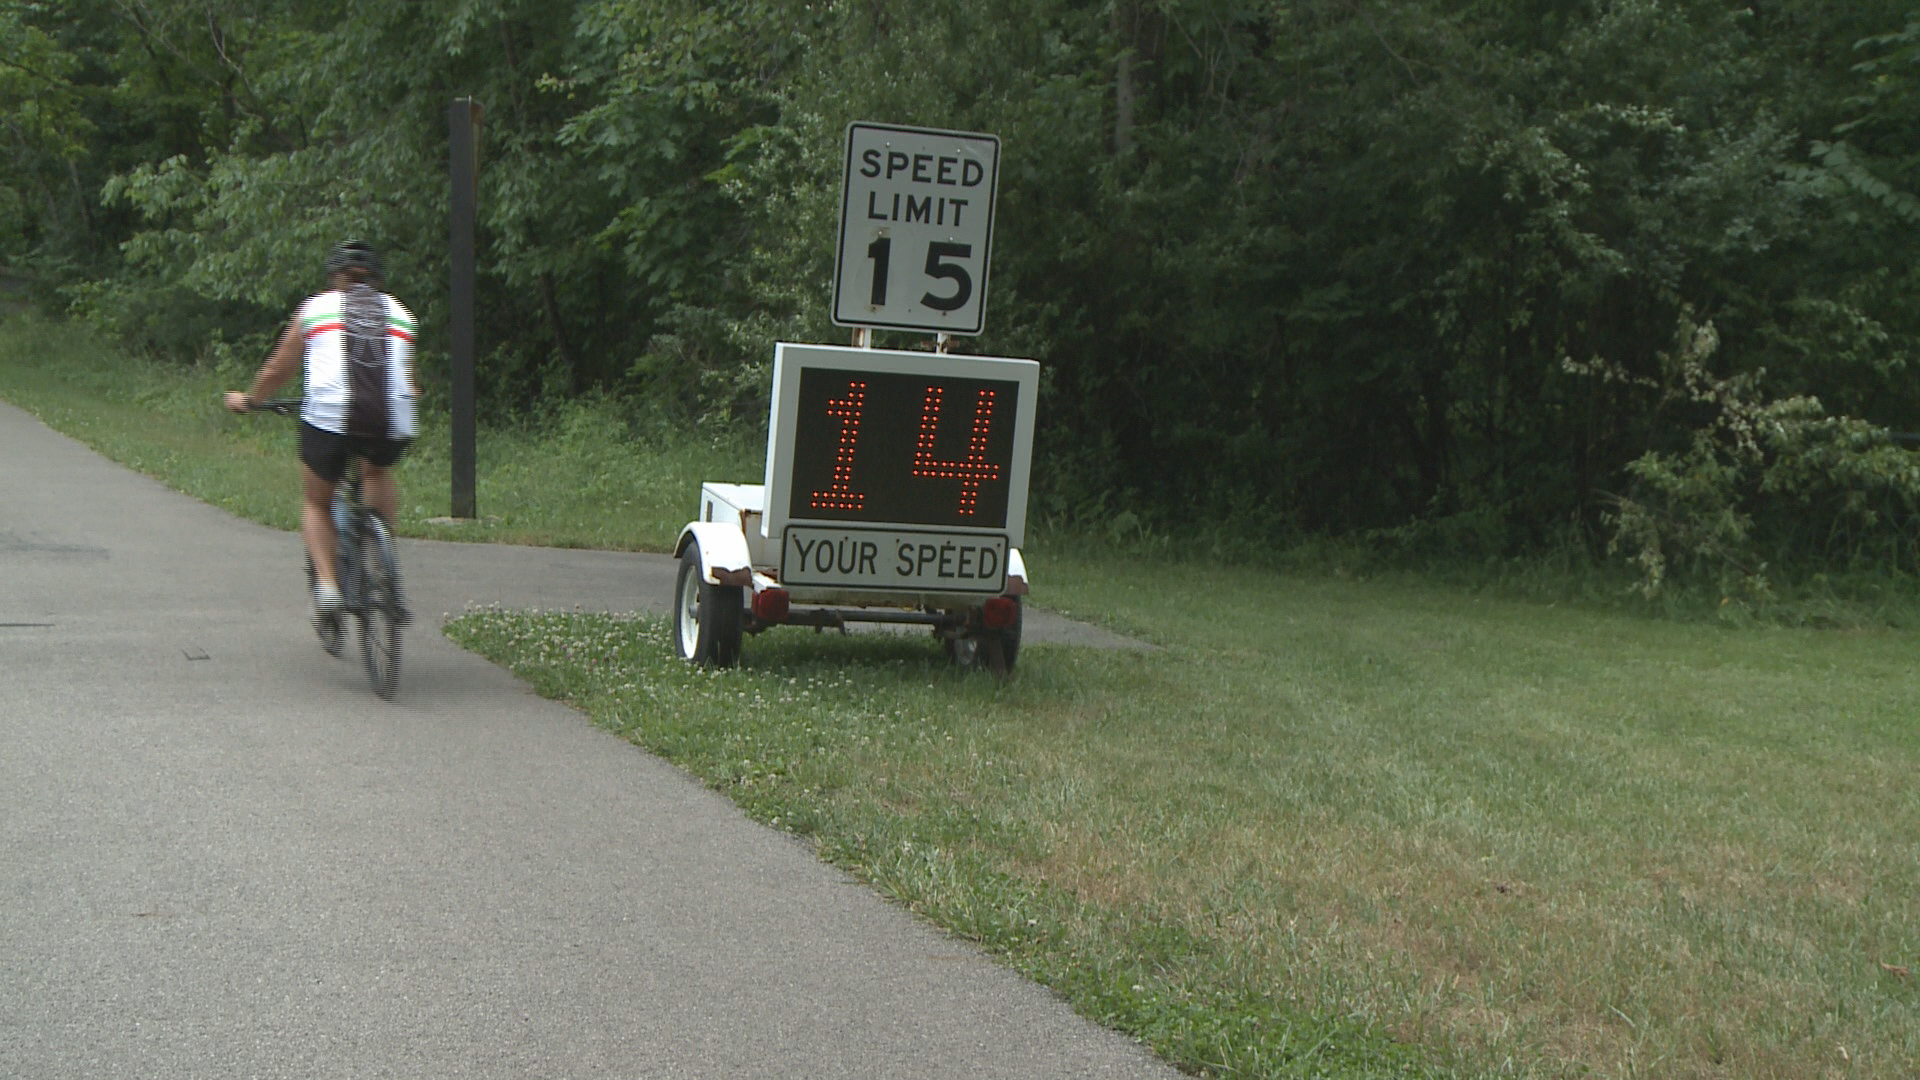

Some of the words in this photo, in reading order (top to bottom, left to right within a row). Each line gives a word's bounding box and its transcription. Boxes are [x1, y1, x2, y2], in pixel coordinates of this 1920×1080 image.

[860, 149, 984, 187] SPEED
[868, 191, 968, 227] LIMIT
[868, 237, 972, 311] 15
[811, 380, 1000, 515] 14
[793, 538, 877, 575] YOUR
[896, 542, 998, 579] SPEED
